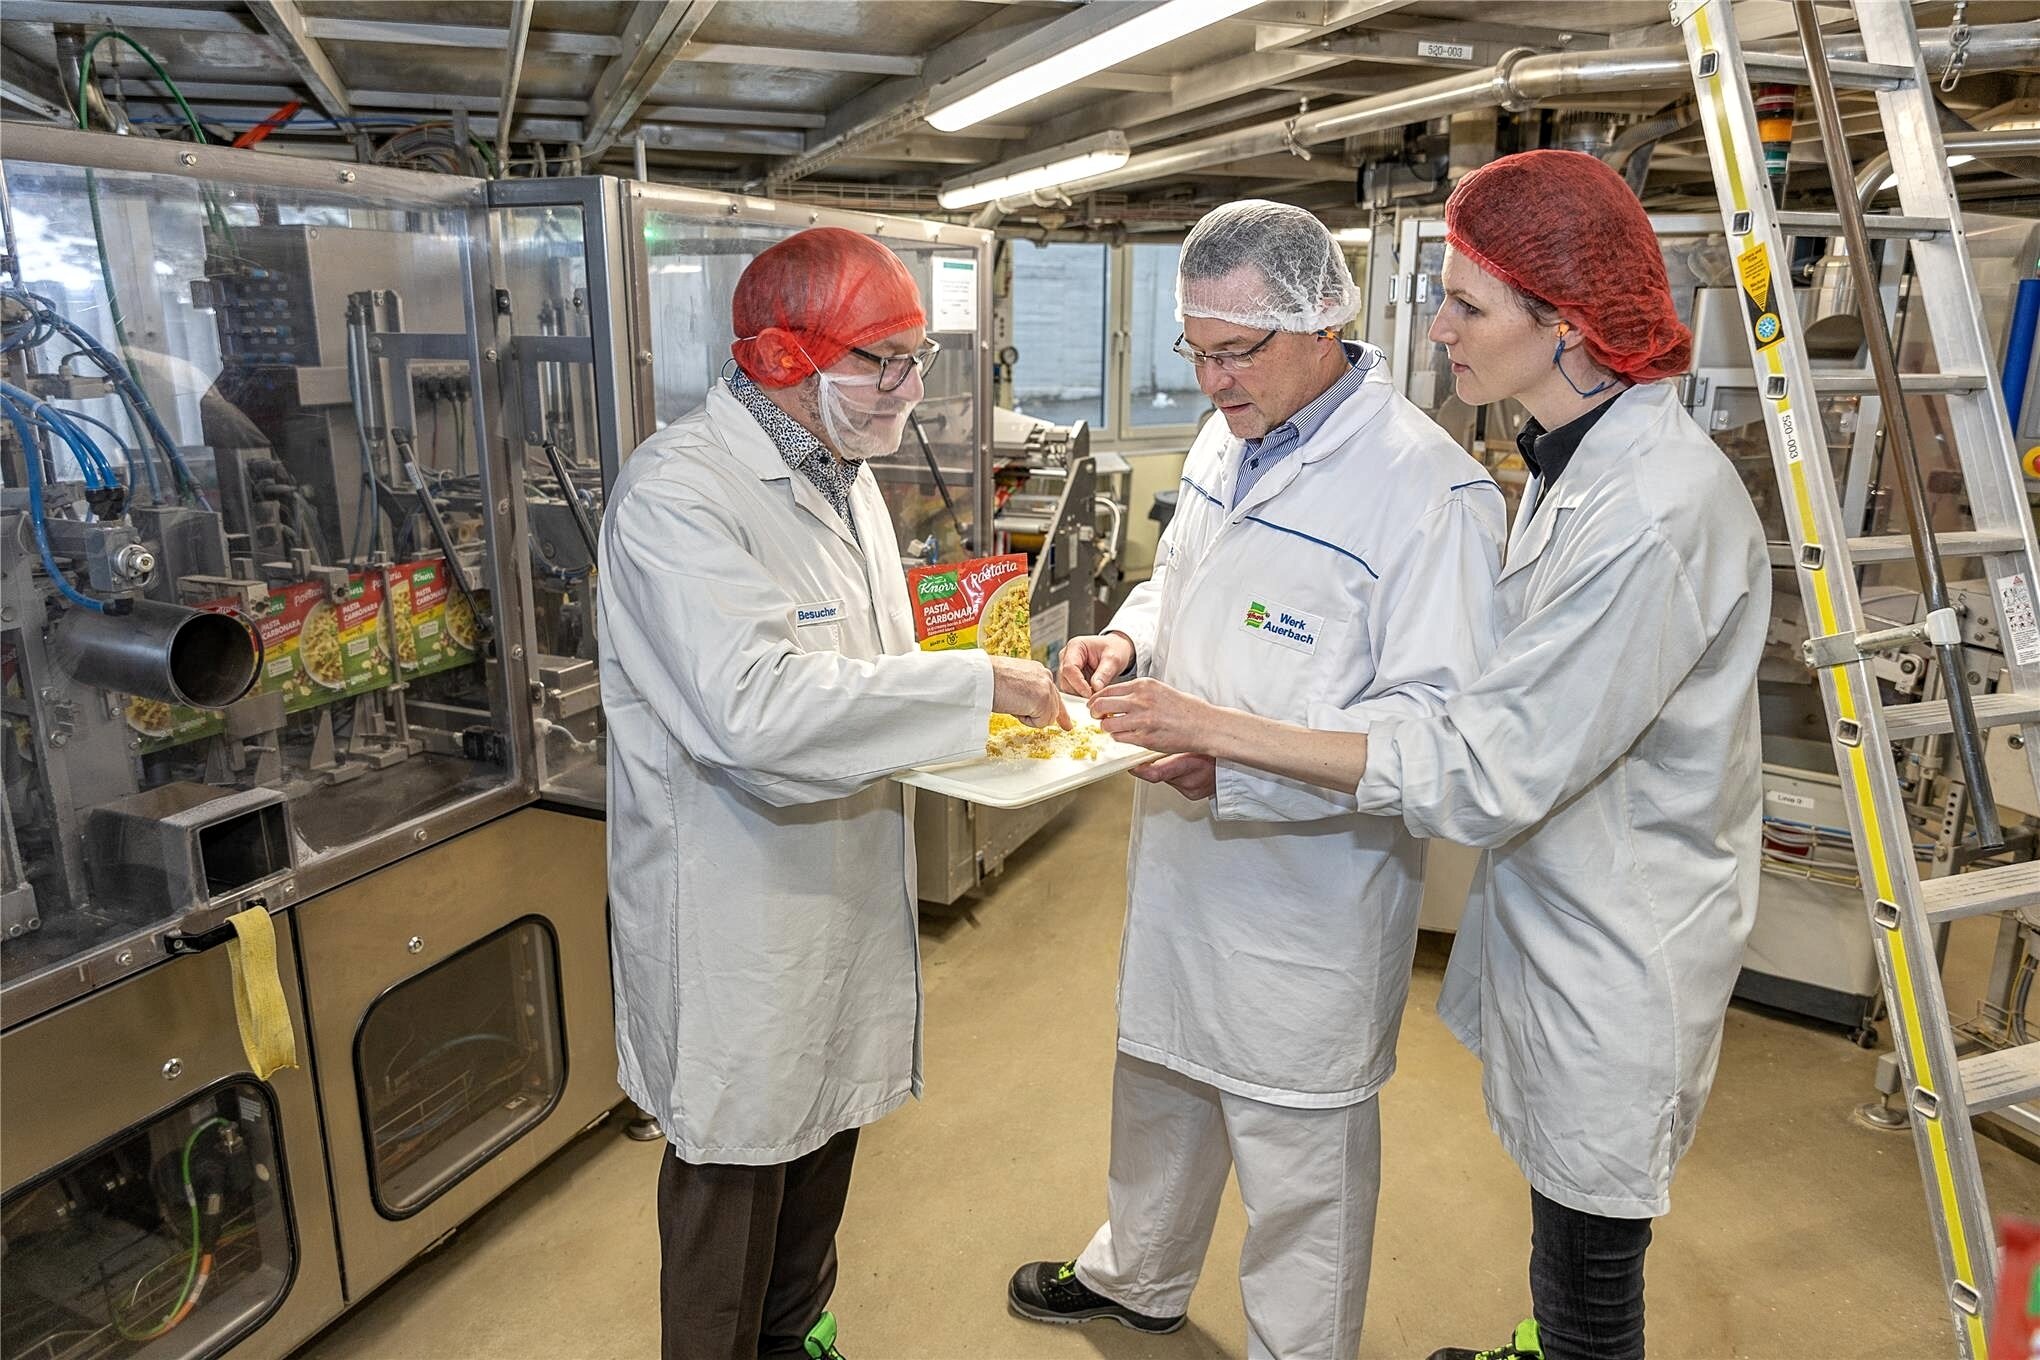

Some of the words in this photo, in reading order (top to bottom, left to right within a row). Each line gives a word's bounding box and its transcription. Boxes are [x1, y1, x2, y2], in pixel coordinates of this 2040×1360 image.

[1428, 44, 1462, 57] 520-003
[1782, 415, 1798, 459] 520-003
[413, 572, 435, 583] Knorr
[415, 586, 432, 598] PASTA
[919, 580, 957, 594] Knorr
[342, 602, 361, 613] PASTA
[344, 602, 378, 621] CARBONARA
[797, 607, 837, 621] Besucher
[923, 602, 950, 616] PASTA
[261, 620, 281, 632] PASTA
[1280, 613, 1306, 630] Werk
[262, 620, 302, 640] CARBONARA
[1263, 621, 1314, 645] Auerbach
